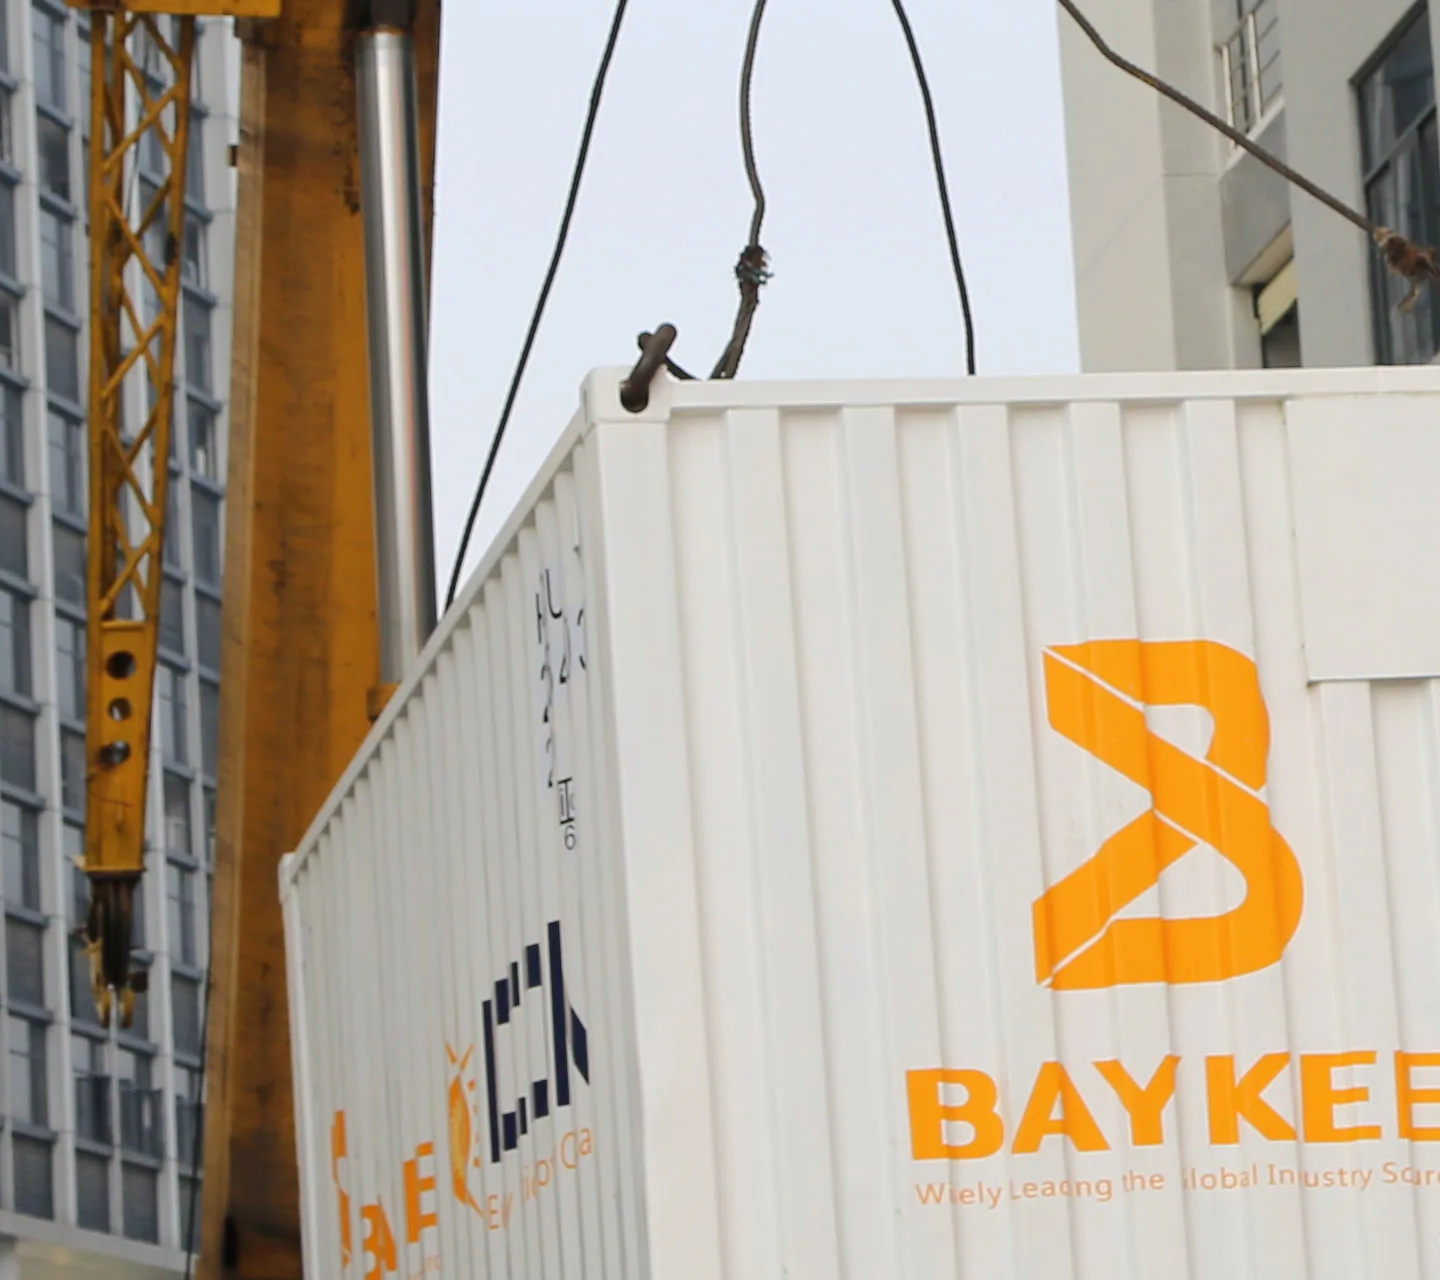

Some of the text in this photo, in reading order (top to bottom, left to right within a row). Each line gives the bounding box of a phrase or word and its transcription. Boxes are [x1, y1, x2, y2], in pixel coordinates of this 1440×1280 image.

[1121, 1169, 1166, 1194] the
[1181, 1162, 1259, 1192] lobal
[1266, 1162, 1374, 1193] Inustry
